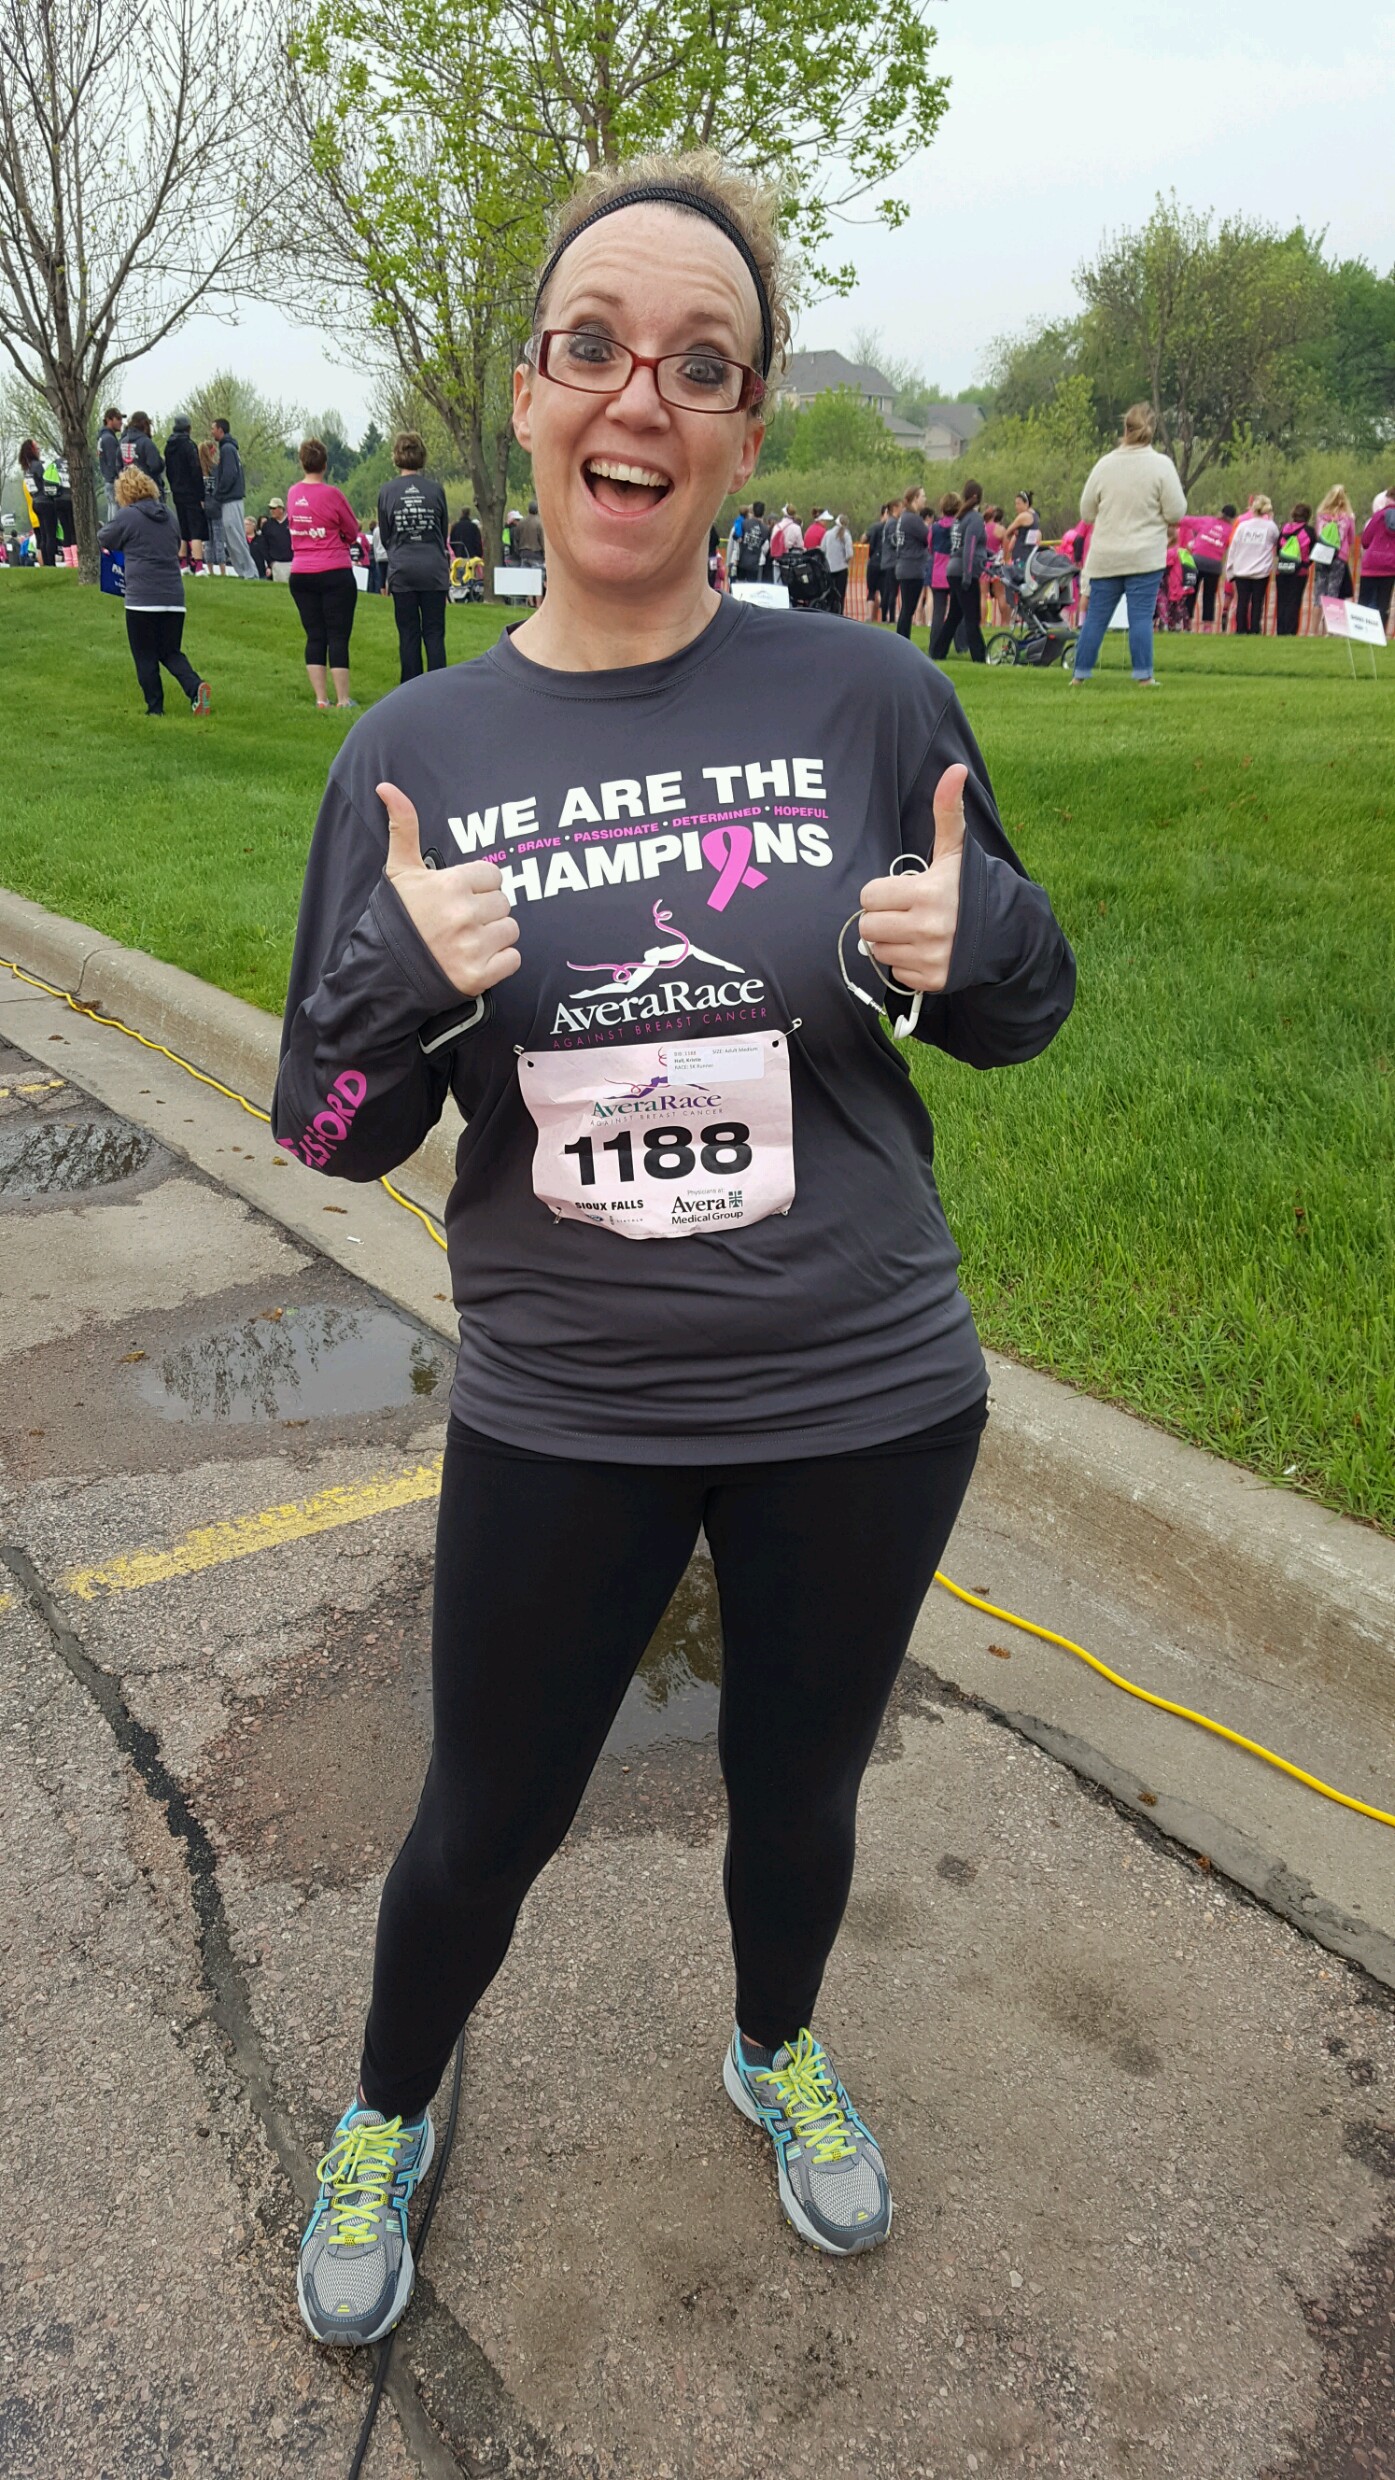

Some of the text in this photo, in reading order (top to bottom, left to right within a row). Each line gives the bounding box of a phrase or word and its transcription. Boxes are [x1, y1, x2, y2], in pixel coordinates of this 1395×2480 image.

[448, 758, 827, 854] WE ARE THE
[517, 837, 561, 854] BRAVE
[573, 822, 660, 843] PASSIONATE
[672, 806, 762, 828] DETERMINED
[774, 805, 829, 819] HOPEFUL
[550, 978, 765, 1035] AveraRace
[552, 1007, 768, 1049] AGAINST BREAST CANCER
[590, 1108, 723, 1127] AGAINST BREAST CANCER
[592, 1094, 722, 1118] AveraRace
[564, 1122, 753, 1186] 1188
[575, 1200, 644, 1211] SIOUX FALLS
[671, 1196, 726, 1213] Avera
[671, 1210, 744, 1224] Medical Group
